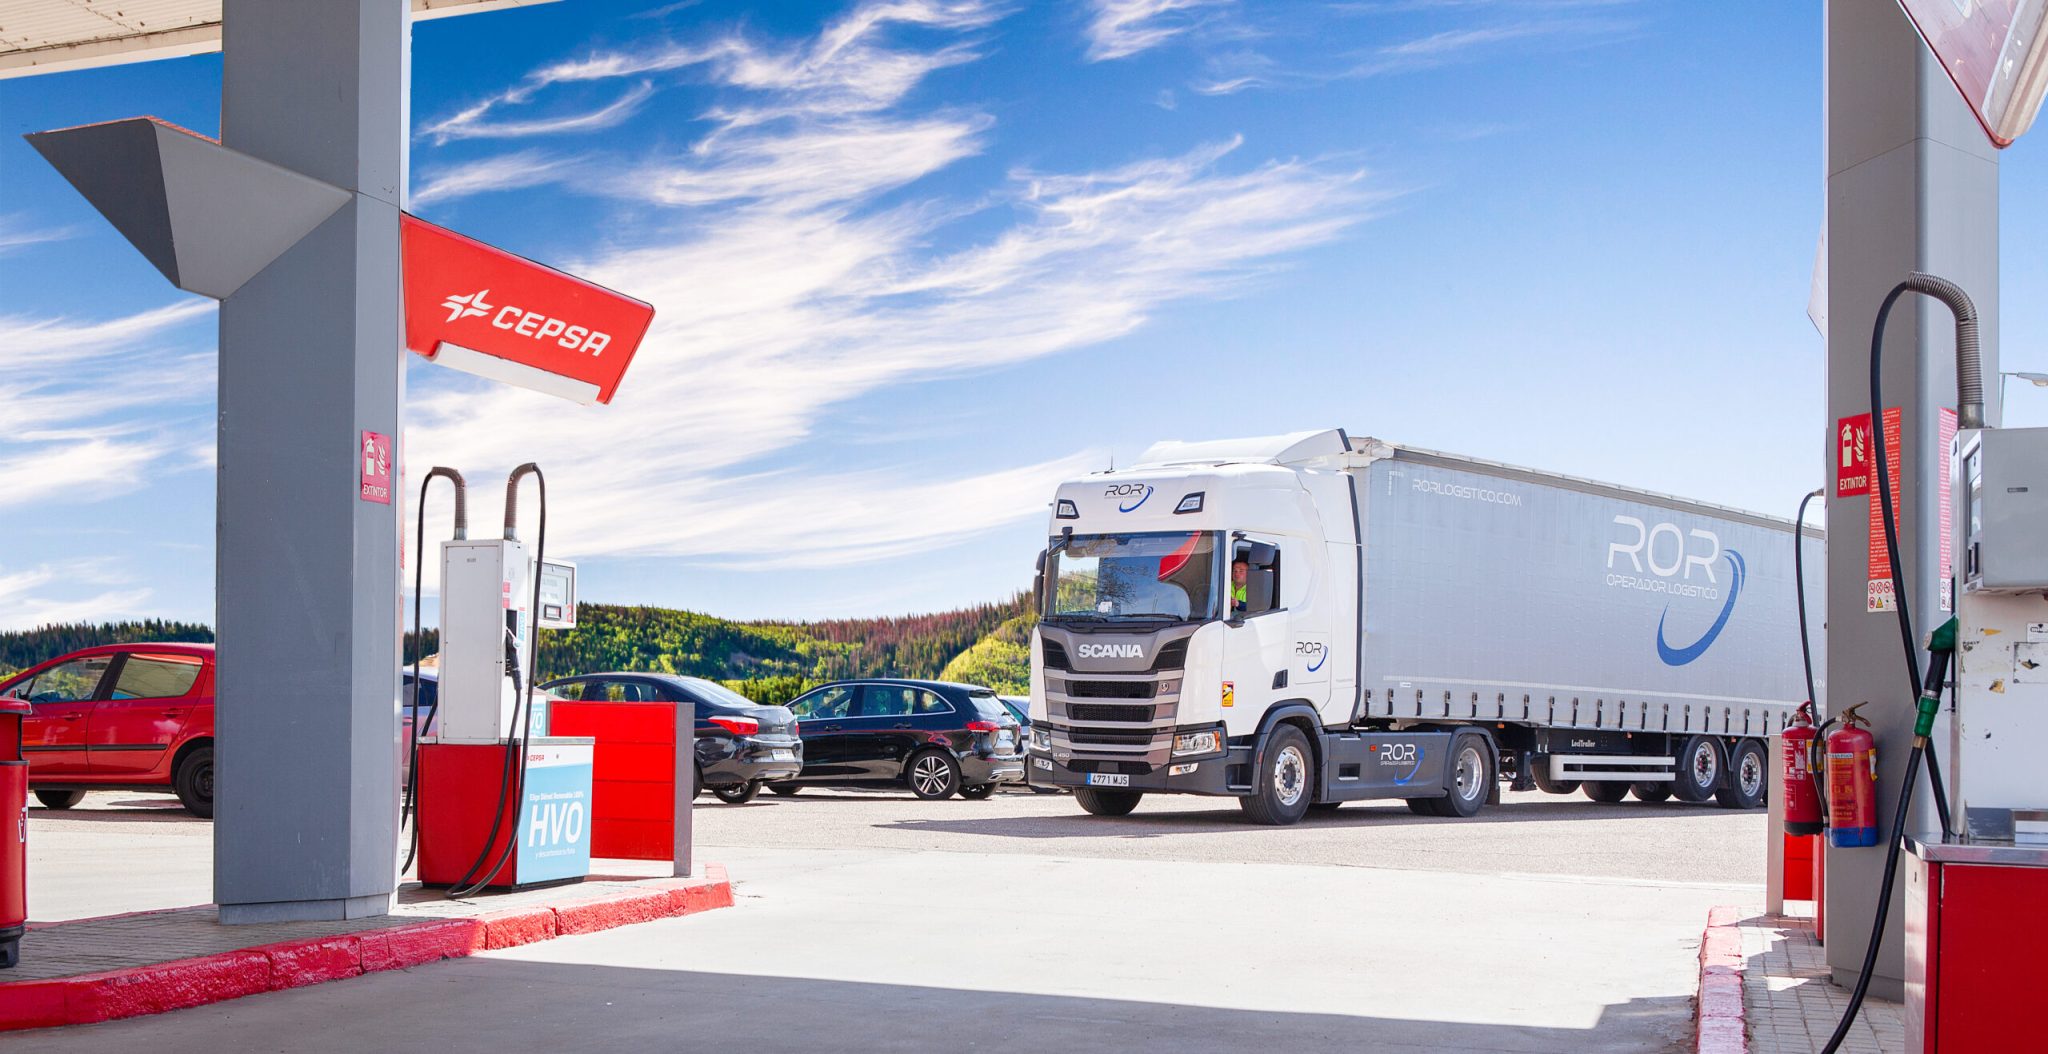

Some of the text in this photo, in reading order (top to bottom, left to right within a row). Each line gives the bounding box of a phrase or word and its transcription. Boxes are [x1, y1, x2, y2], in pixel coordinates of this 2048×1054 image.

[492, 305, 611, 357] CEPSA
[363, 485, 388, 499] EXTINTOR
[1104, 483, 1145, 496] ROR
[1839, 475, 1867, 491] EXTINTOR
[1412, 479, 1522, 507] RORLOGISTICO.COM
[1607, 514, 1720, 584] ROR
[1606, 573, 1718, 600] OPERADOR LOGISTICO
[1078, 643, 1144, 659] SCANIA
[1295, 641, 1322, 654] ROR
[529, 712, 544, 730] VO
[1380, 743, 1416, 761] ROR
[1092, 775, 1128, 785] 4771 MJS
[528, 801, 584, 848] HVO
